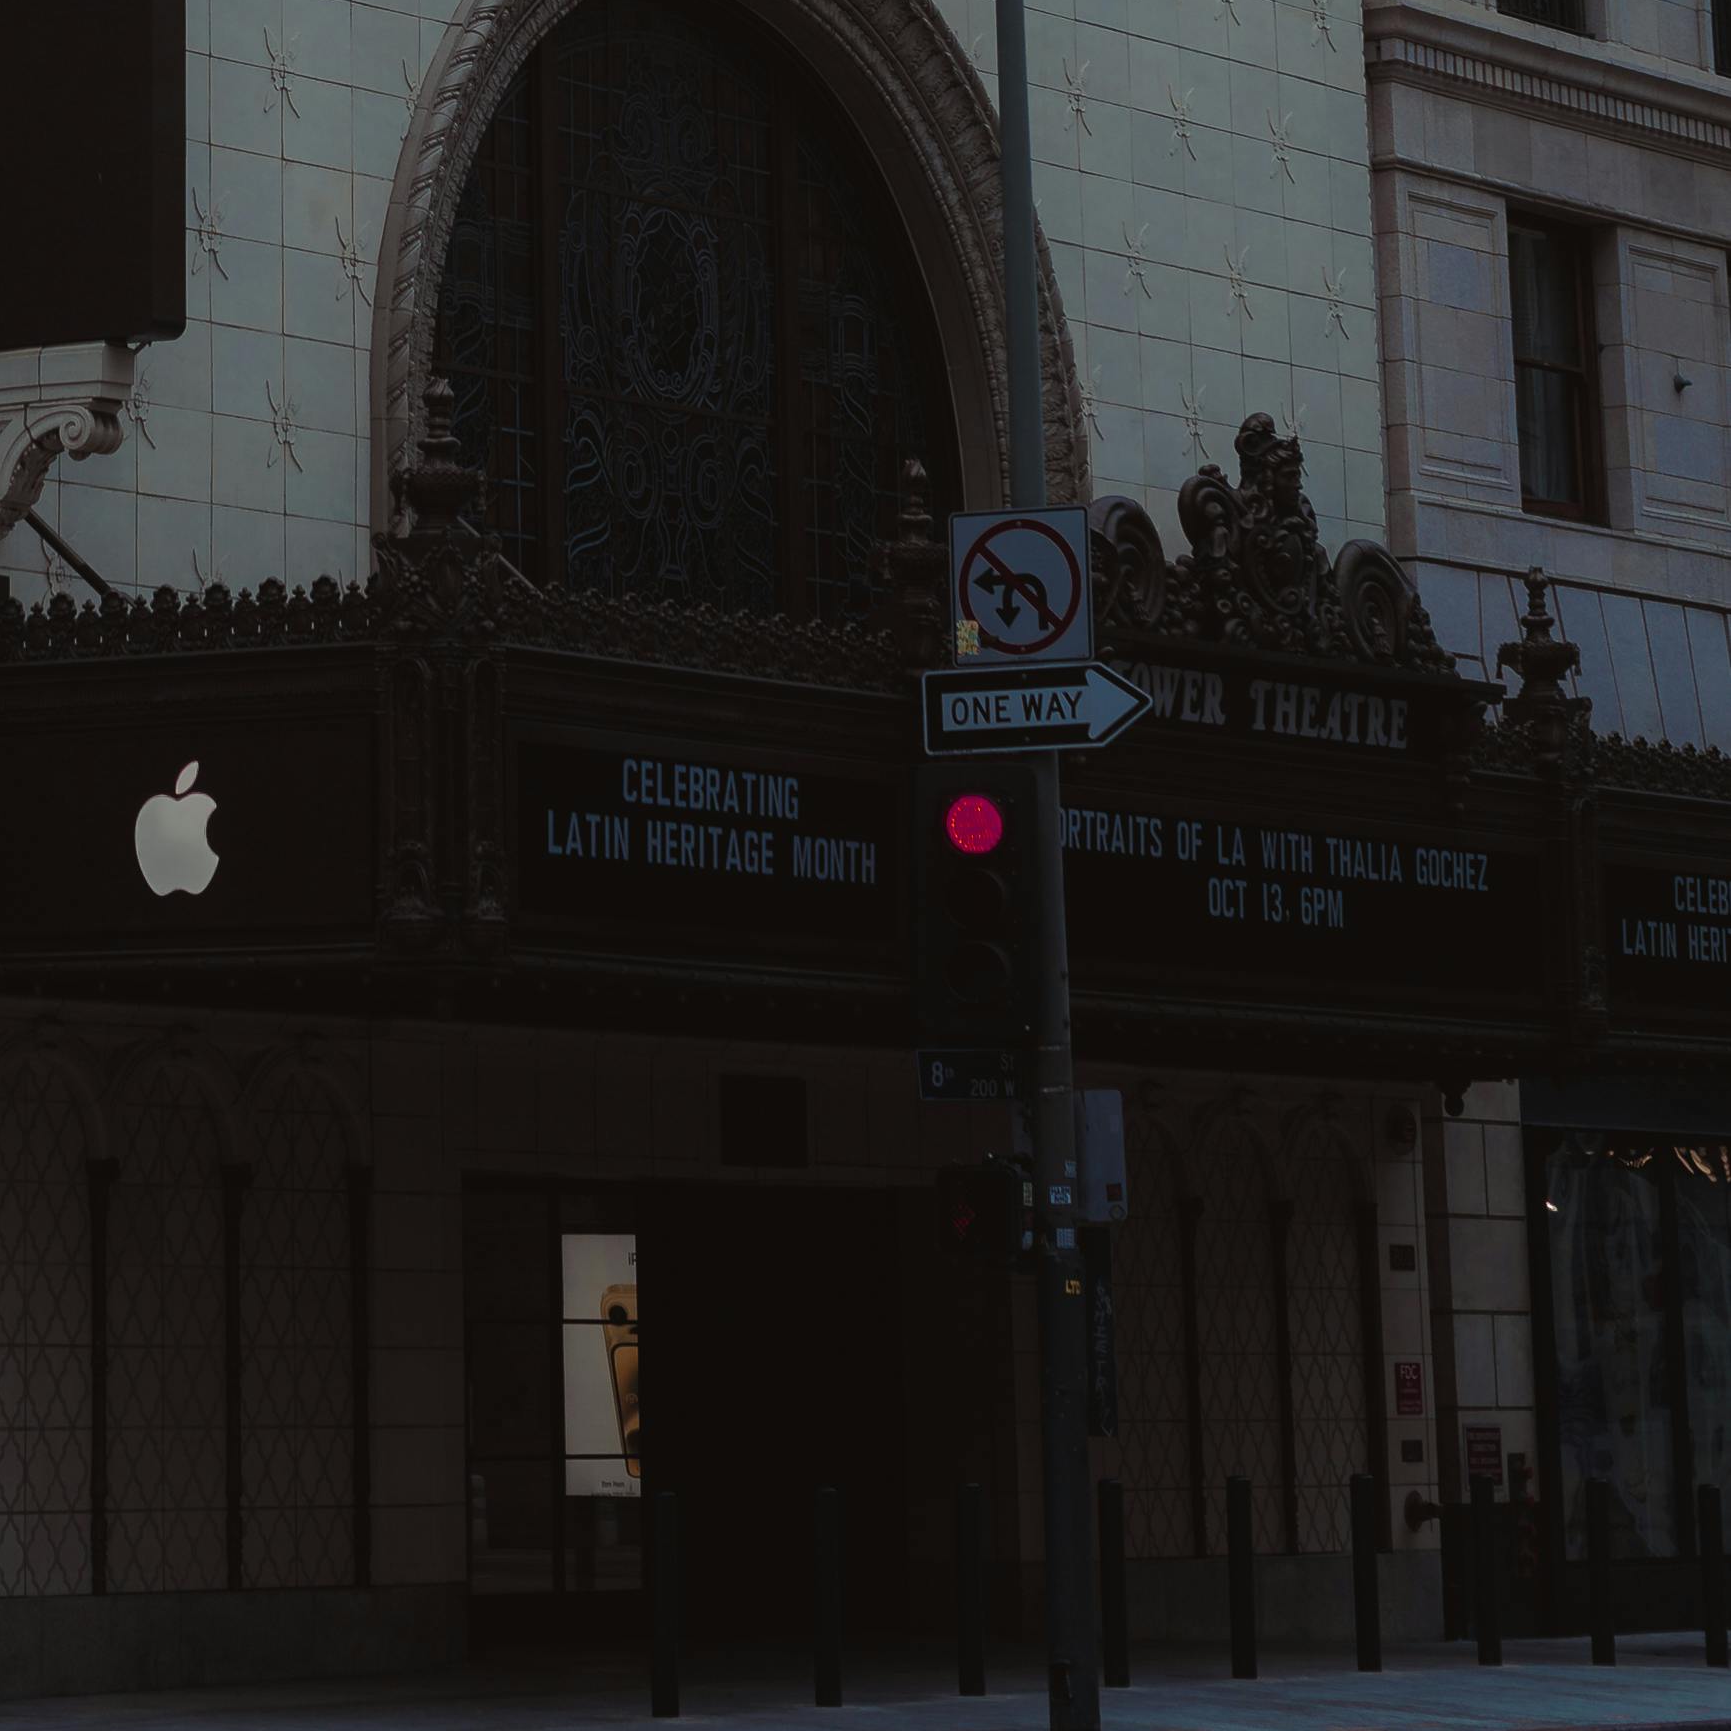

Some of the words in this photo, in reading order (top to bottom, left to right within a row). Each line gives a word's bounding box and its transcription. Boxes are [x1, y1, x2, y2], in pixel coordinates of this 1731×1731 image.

[951, 695, 1011, 725] ONE
[1022, 691, 1082, 722] WAY
[1248, 679, 1408, 749] THEATRE
[622, 757, 799, 820] CELEBRATING
[546, 808, 630, 861] LATIN
[646, 819, 774, 875] HERITAGE
[792, 834, 877, 884] MONTH
[1058, 807, 1163, 858] ORTRAITS
[1176, 820, 1203, 861] OF
[1216, 824, 1246, 867] LA
[1260, 829, 1313, 874] WITH
[1325, 837, 1403, 883] THALIA
[1414, 847, 1488, 891] GOCHEZ
[1207, 876, 1247, 920] OCT
[1299, 886, 1344, 928] 6PM
[1673, 875, 1731, 915] CELEB
[1621, 918, 1678, 959] LATIN
[1687, 923, 1731, 963] HERI
[970, 1078, 998, 1097] 200
